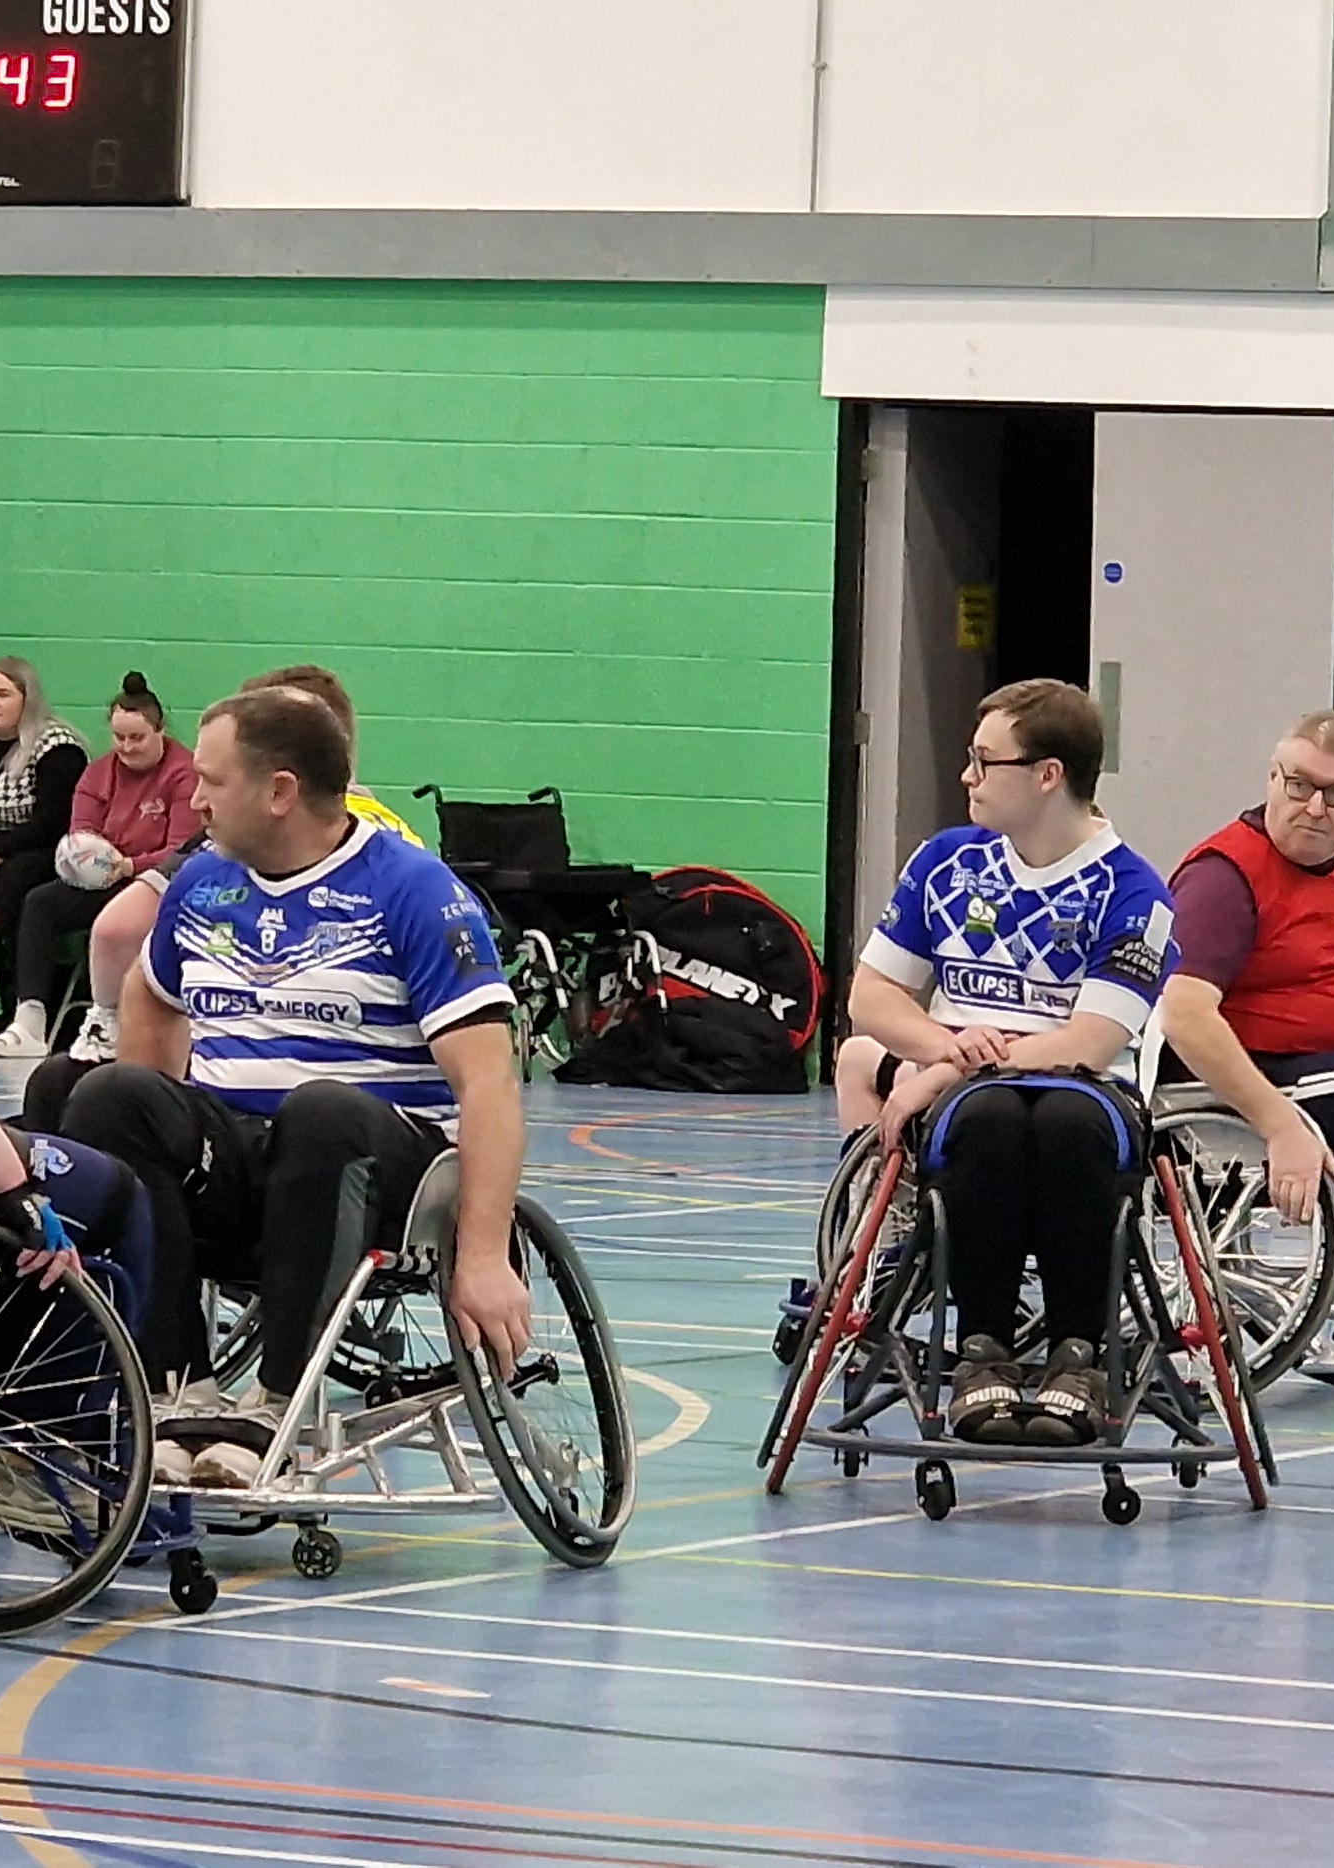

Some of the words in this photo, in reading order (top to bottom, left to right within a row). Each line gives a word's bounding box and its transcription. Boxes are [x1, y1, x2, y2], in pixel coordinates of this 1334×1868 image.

[43, 0, 171, 35] GUESTS
[260, 929, 277, 955] 8
[948, 969, 1020, 1000] ECLIPSE
[264, 999, 351, 1023] ENERGY
